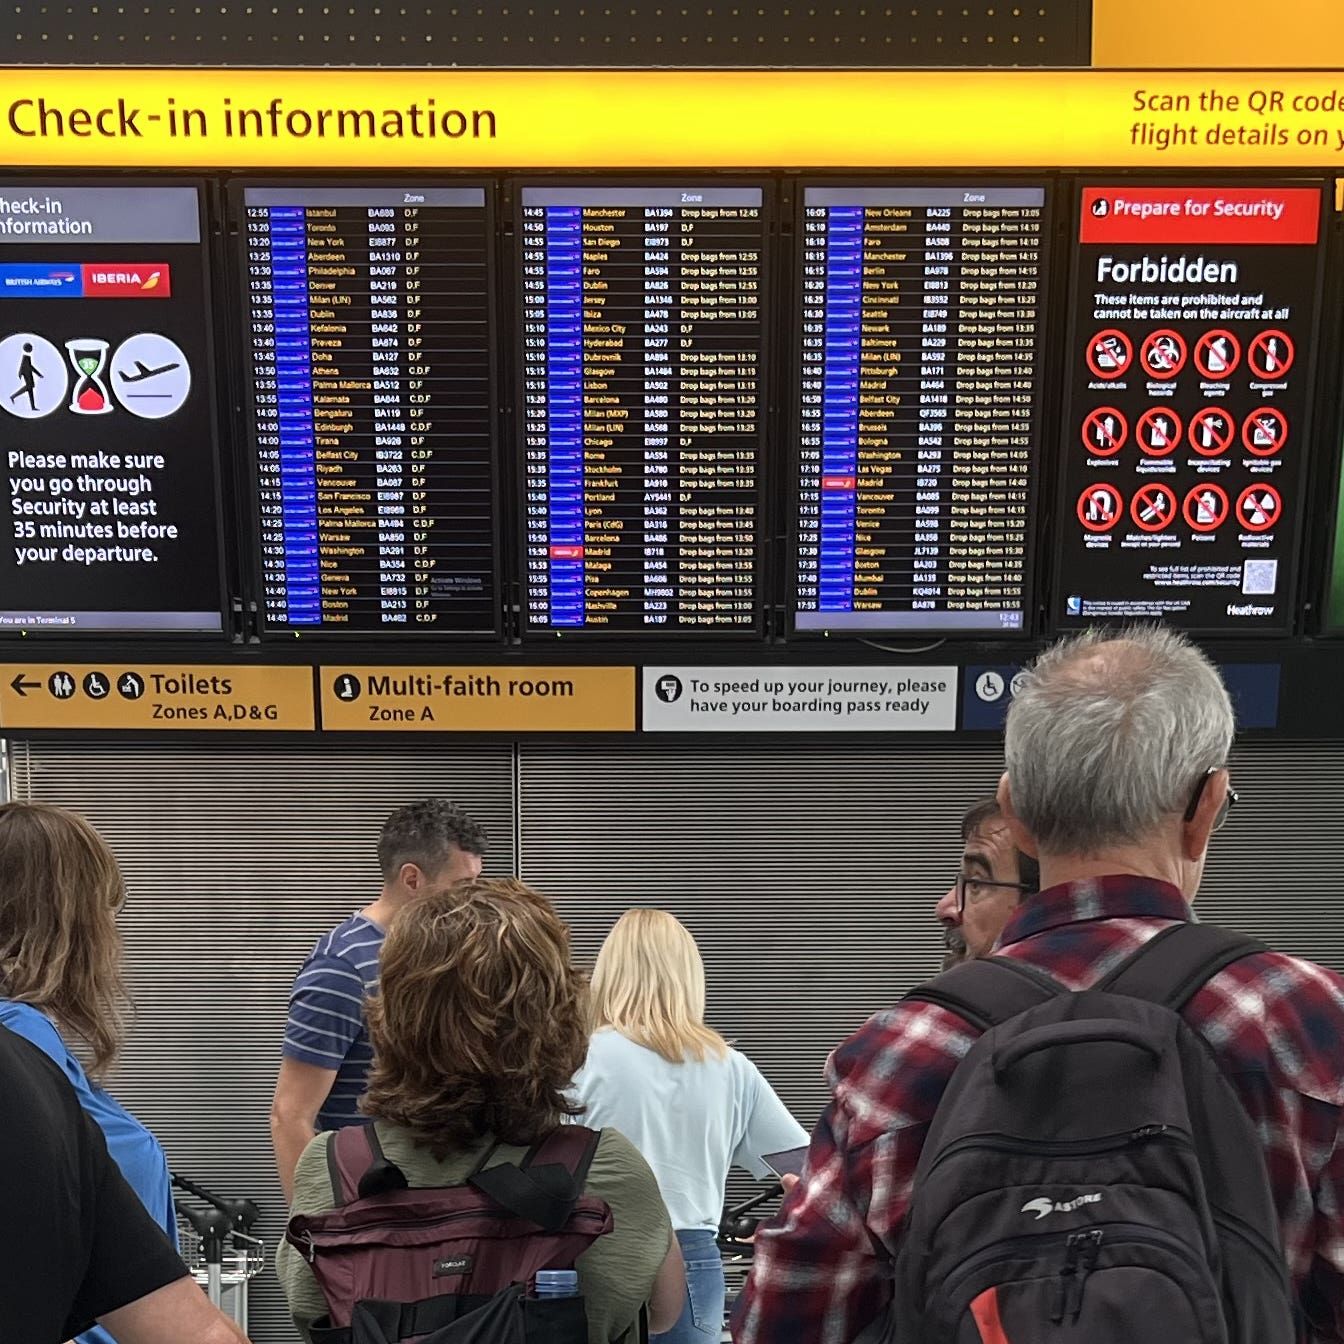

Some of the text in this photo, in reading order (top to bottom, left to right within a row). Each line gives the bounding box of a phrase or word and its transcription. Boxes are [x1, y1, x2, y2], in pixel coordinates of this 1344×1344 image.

[1133, 90, 1190, 112] Scan
[1199, 90, 1240, 112] the
[1247, 90, 1285, 114] QR
[8, 98, 497, 139] Check-in information
[1130, 123, 1198, 152] flight
[1205, 124, 1289, 146] details
[1297, 129, 1328, 146] on
[681, 193, 702, 202] Zone
[963, 193, 985, 202] Zone
[681, 209, 699, 218] Drop
[701, 208, 718, 218] bags
[719, 208, 737, 217] from
[865, 208, 882, 217] New
[963, 209, 981, 218] Drop
[983, 208, 1000, 218] bags
[1001, 208, 1019, 217] from
[1113, 199, 1284, 220] Prepare for Security
[1097, 256, 1238, 283] Forbidden
[92, 273, 141, 284] IBERIA
[1094, 294, 1263, 307] These items are prohibited and
[1094, 308, 1289, 319] cannot be taken on the aircraft at all
[83, 360, 94, 369] 35
[8, 451, 165, 469] Please make sure
[953, 465, 970, 475] Drop
[973, 465, 989, 475] bags
[990, 465, 1007, 474] from
[10, 475, 152, 496] you go through
[12, 498, 157, 518] Security at least
[14, 521, 178, 538] 35 minutes before
[15, 545, 158, 565] your departure.
[1227, 604, 1274, 616] Heathrow
[150, 674, 233, 695] Toilets
[368, 675, 574, 697] Multi-faith room
[690, 679, 947, 697] To speed up your journey, please
[152, 704, 208, 720] Zones
[369, 705, 434, 722] Zone A
[690, 699, 930, 715] have your boarding pass ready
